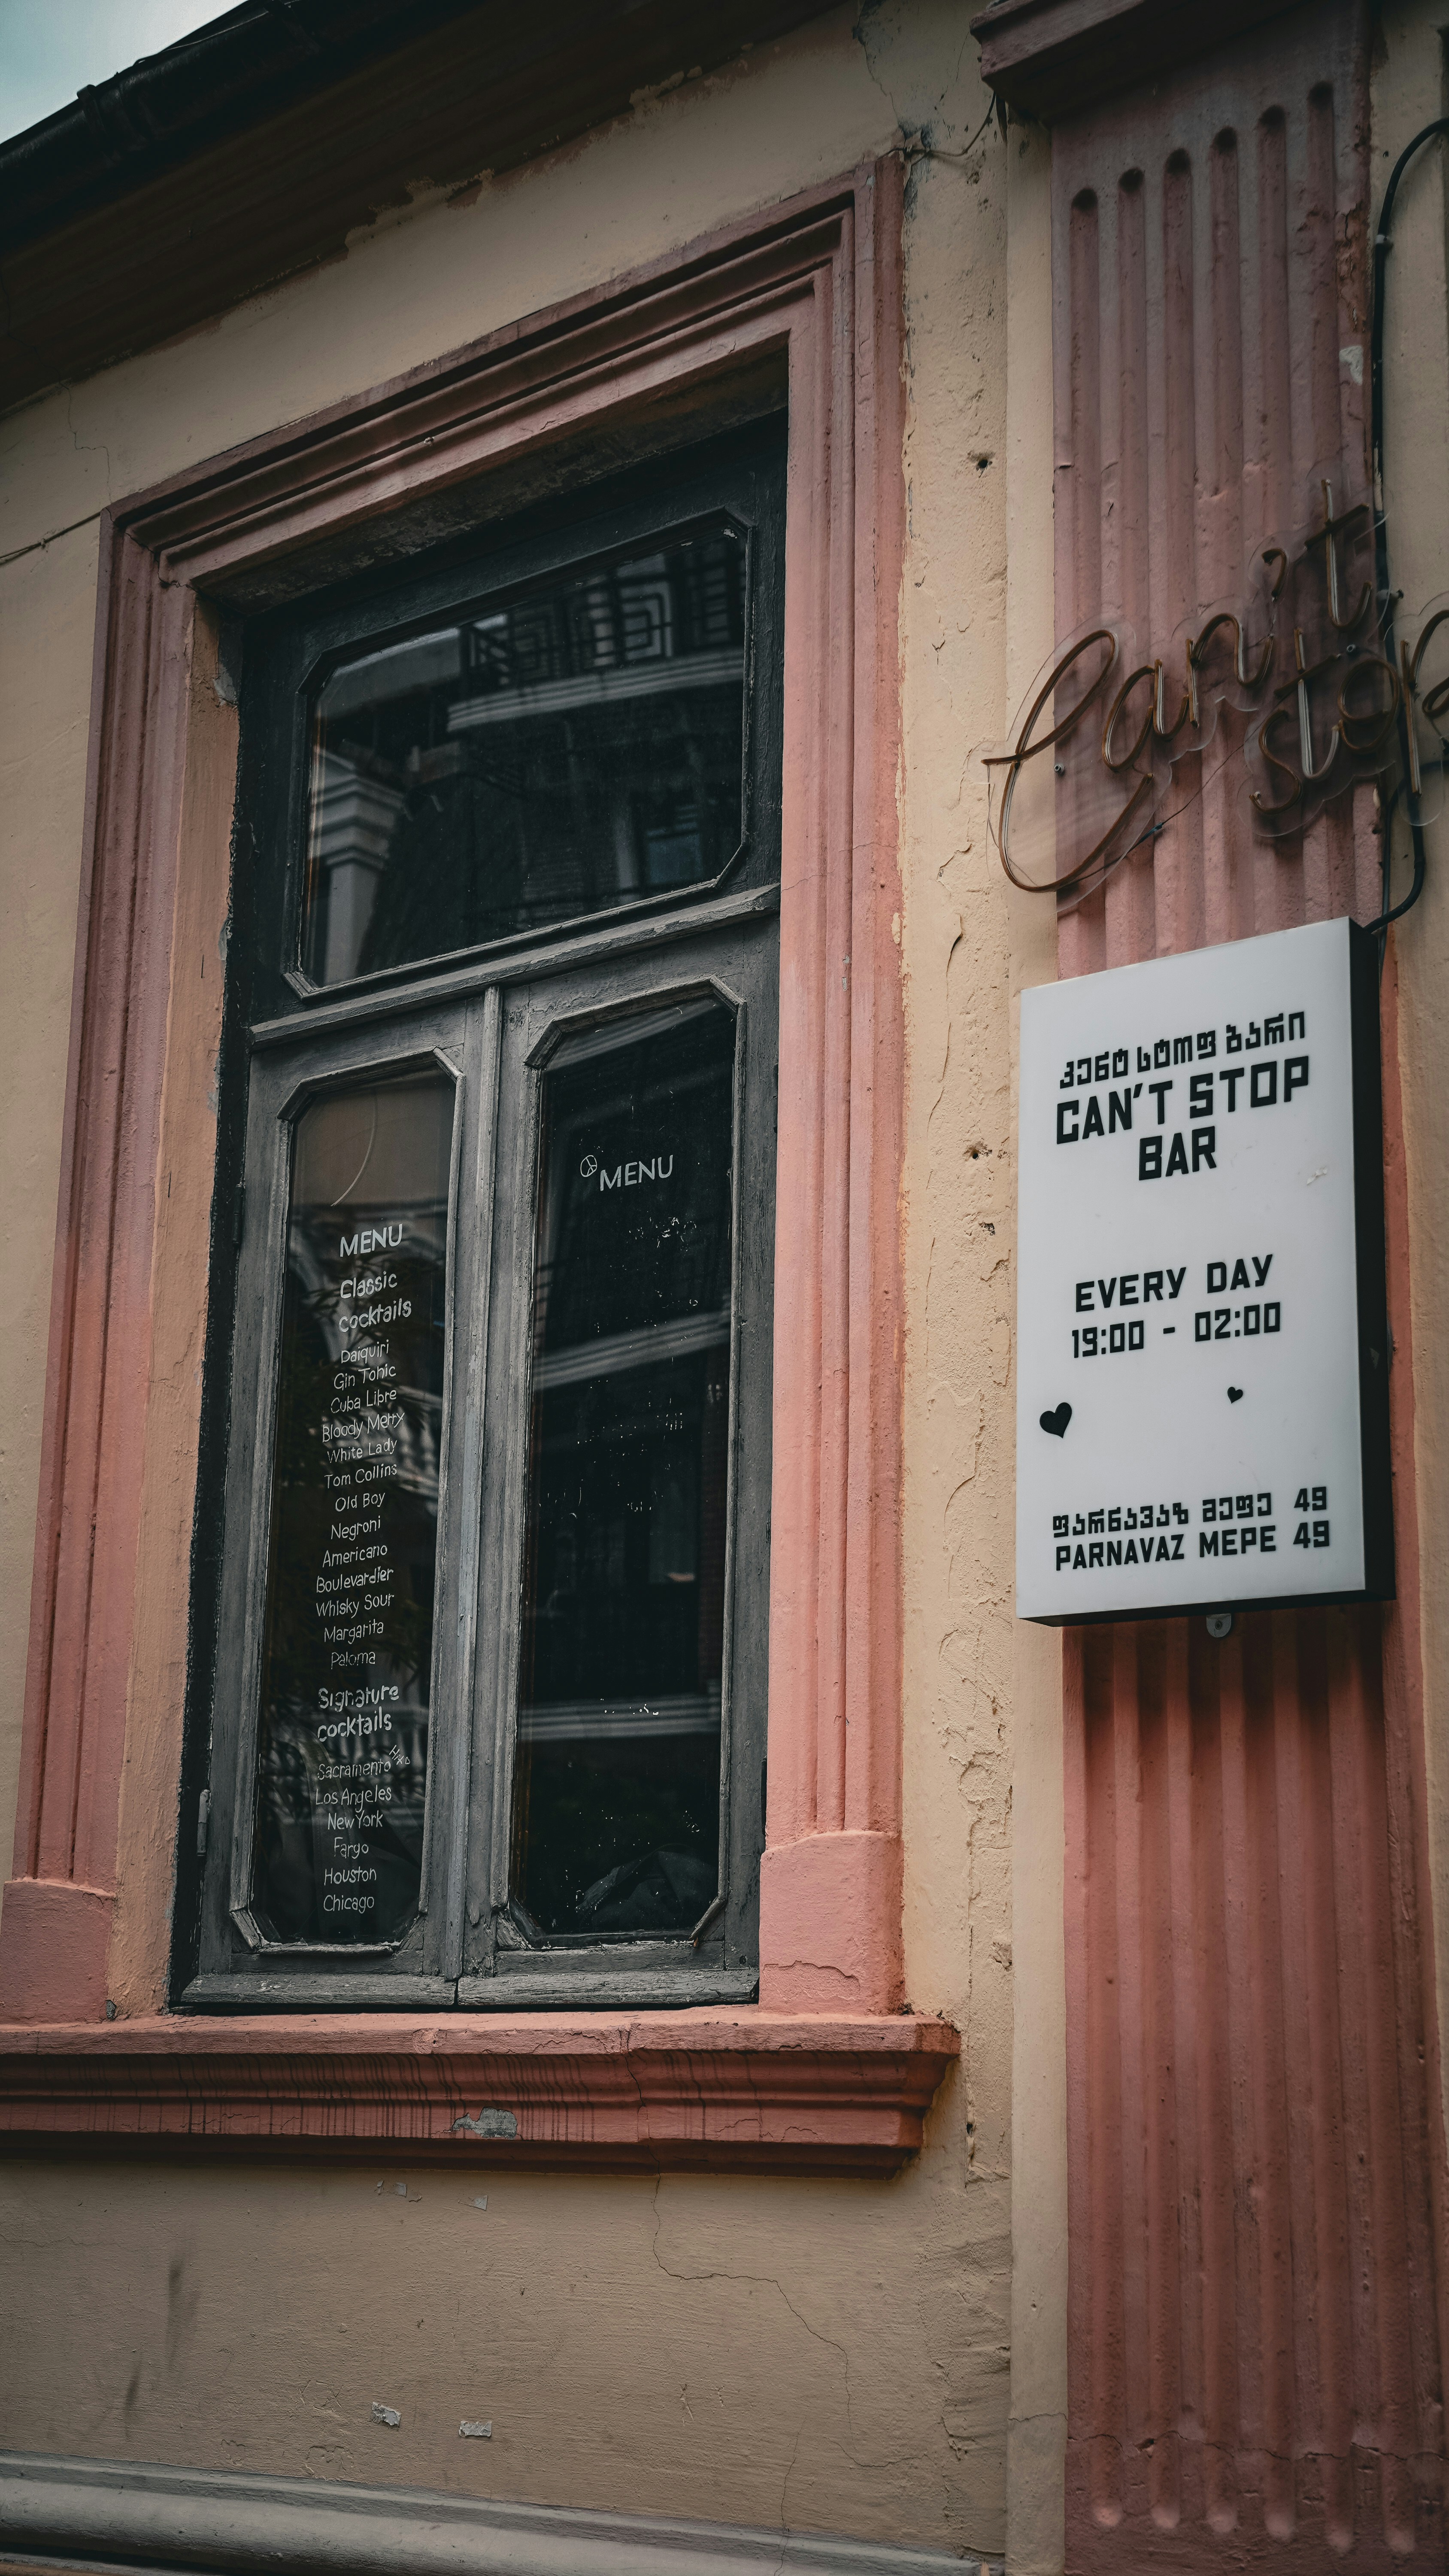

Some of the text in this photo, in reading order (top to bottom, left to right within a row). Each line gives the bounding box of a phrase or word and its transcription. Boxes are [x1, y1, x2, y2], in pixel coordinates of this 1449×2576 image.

[1060, 1011, 1305, 1089] კენტ სტოფ ბარი
[1056, 1055, 1310, 1145] CAN'T STOP
[1139, 1125, 1217, 1181] BAR
[600, 1154, 673, 1191] MENU
[340, 1224, 403, 1257] MENU
[340, 1271, 397, 1299] Classic
[1076, 1254, 1273, 1312] EVERY DAY
[339, 1298, 412, 1332] cocktails
[1071, 1301, 1281, 1358] 19:00 - 02:00
[341, 1340, 389, 1364] Daiquiri
[334, 1364, 396, 1390] Gin Tonic
[331, 1389, 397, 1413] Cuba Libre
[322, 1413, 405, 1443] Bloody Merry
[327, 1437, 397, 1463] White Lady
[324, 1463, 397, 1488] Tom Collins
[335, 1492, 385, 1512] Old Boy
[1052, 1486, 1327, 1538] ფარნავაზ მეფე 49
[331, 1516, 381, 1541] Negroni
[322, 1545, 388, 1567] Americano
[1055, 1520, 1330, 1571] PARNAVAZ MEPE 49
[317, 1566, 394, 1593] Boulevardier
[316, 1593, 394, 1619] Whisky Sour
[324, 1619, 384, 1644] Margarita
[331, 1651, 376, 1670] Paloma
[318, 1685, 399, 1712] Signature
[318, 1706, 392, 1742] cocktails
[317, 1758, 391, 1780] Sacramento
[315, 1784, 392, 1813] Los Angeles
[327, 1810, 383, 1830] New York
[333, 1837, 369, 1859] Fargo
[324, 1866, 376, 1886] Houston
[323, 1894, 374, 1914] Chicago
